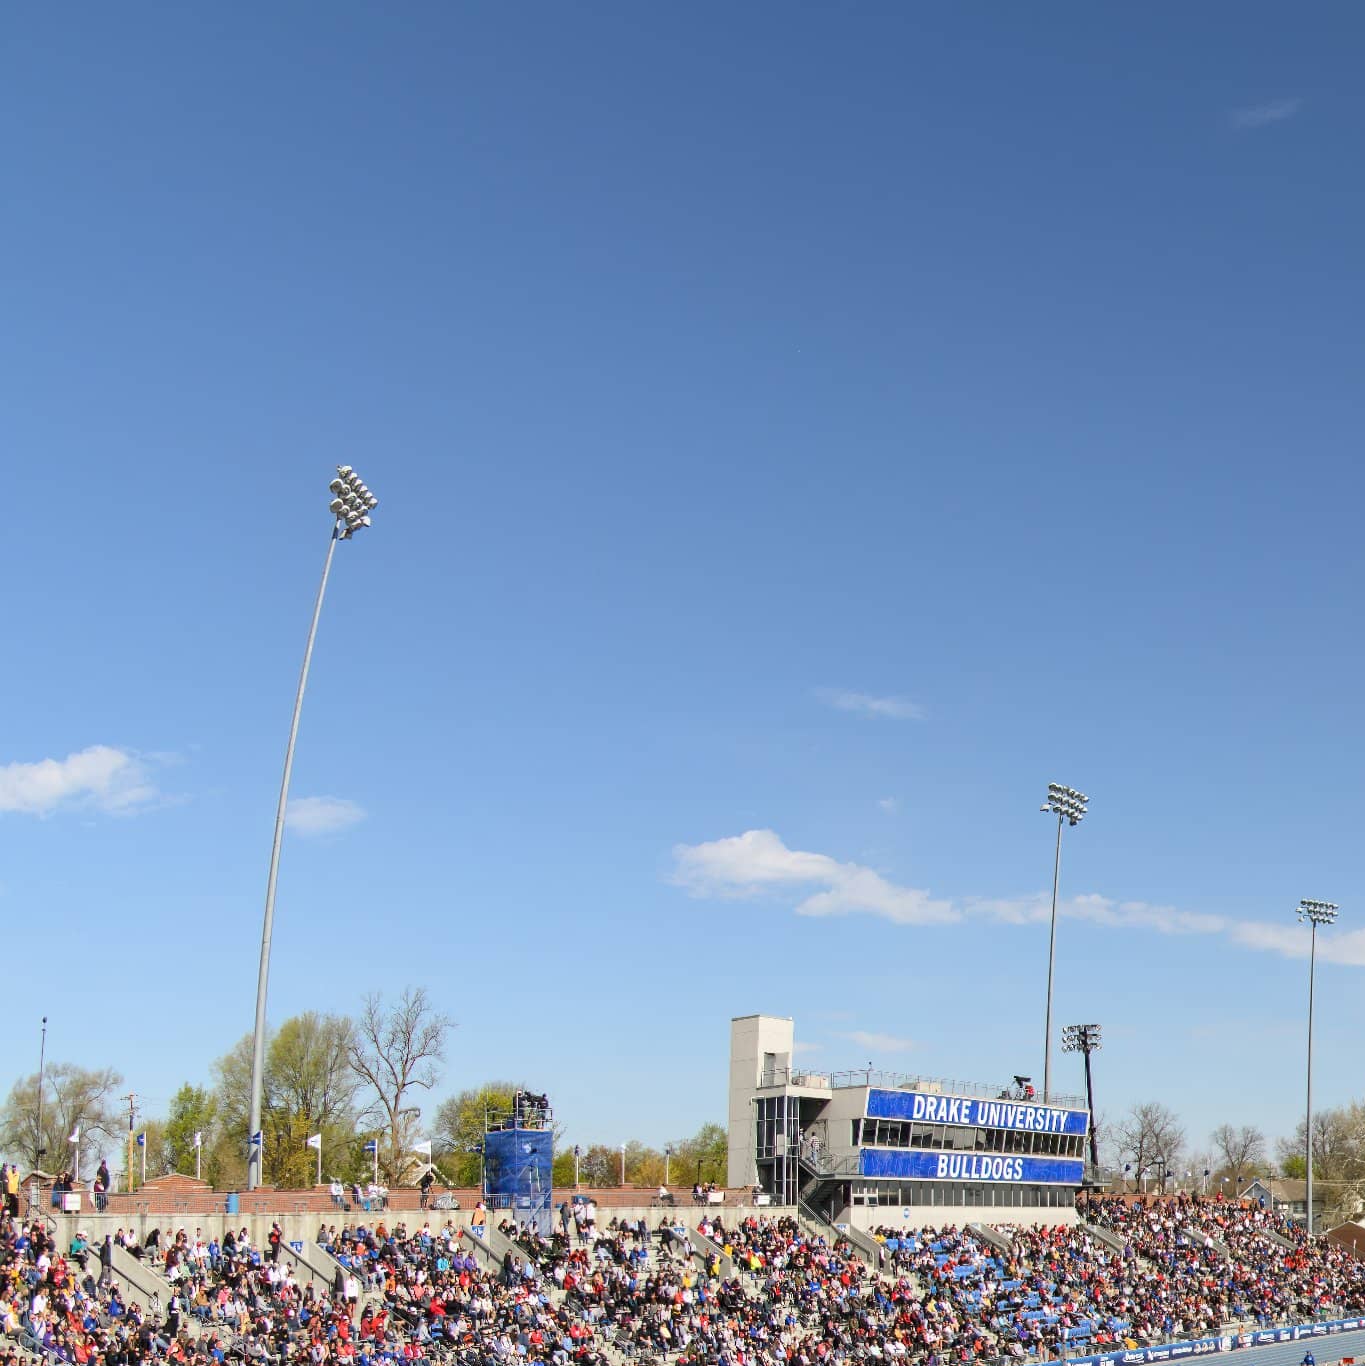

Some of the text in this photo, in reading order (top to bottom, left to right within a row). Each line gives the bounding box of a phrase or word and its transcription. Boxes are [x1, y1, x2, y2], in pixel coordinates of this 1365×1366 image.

[913, 1096, 1069, 1132] DRAKE UNIVERSITY
[937, 1154, 1023, 1180] BULLDOGS
